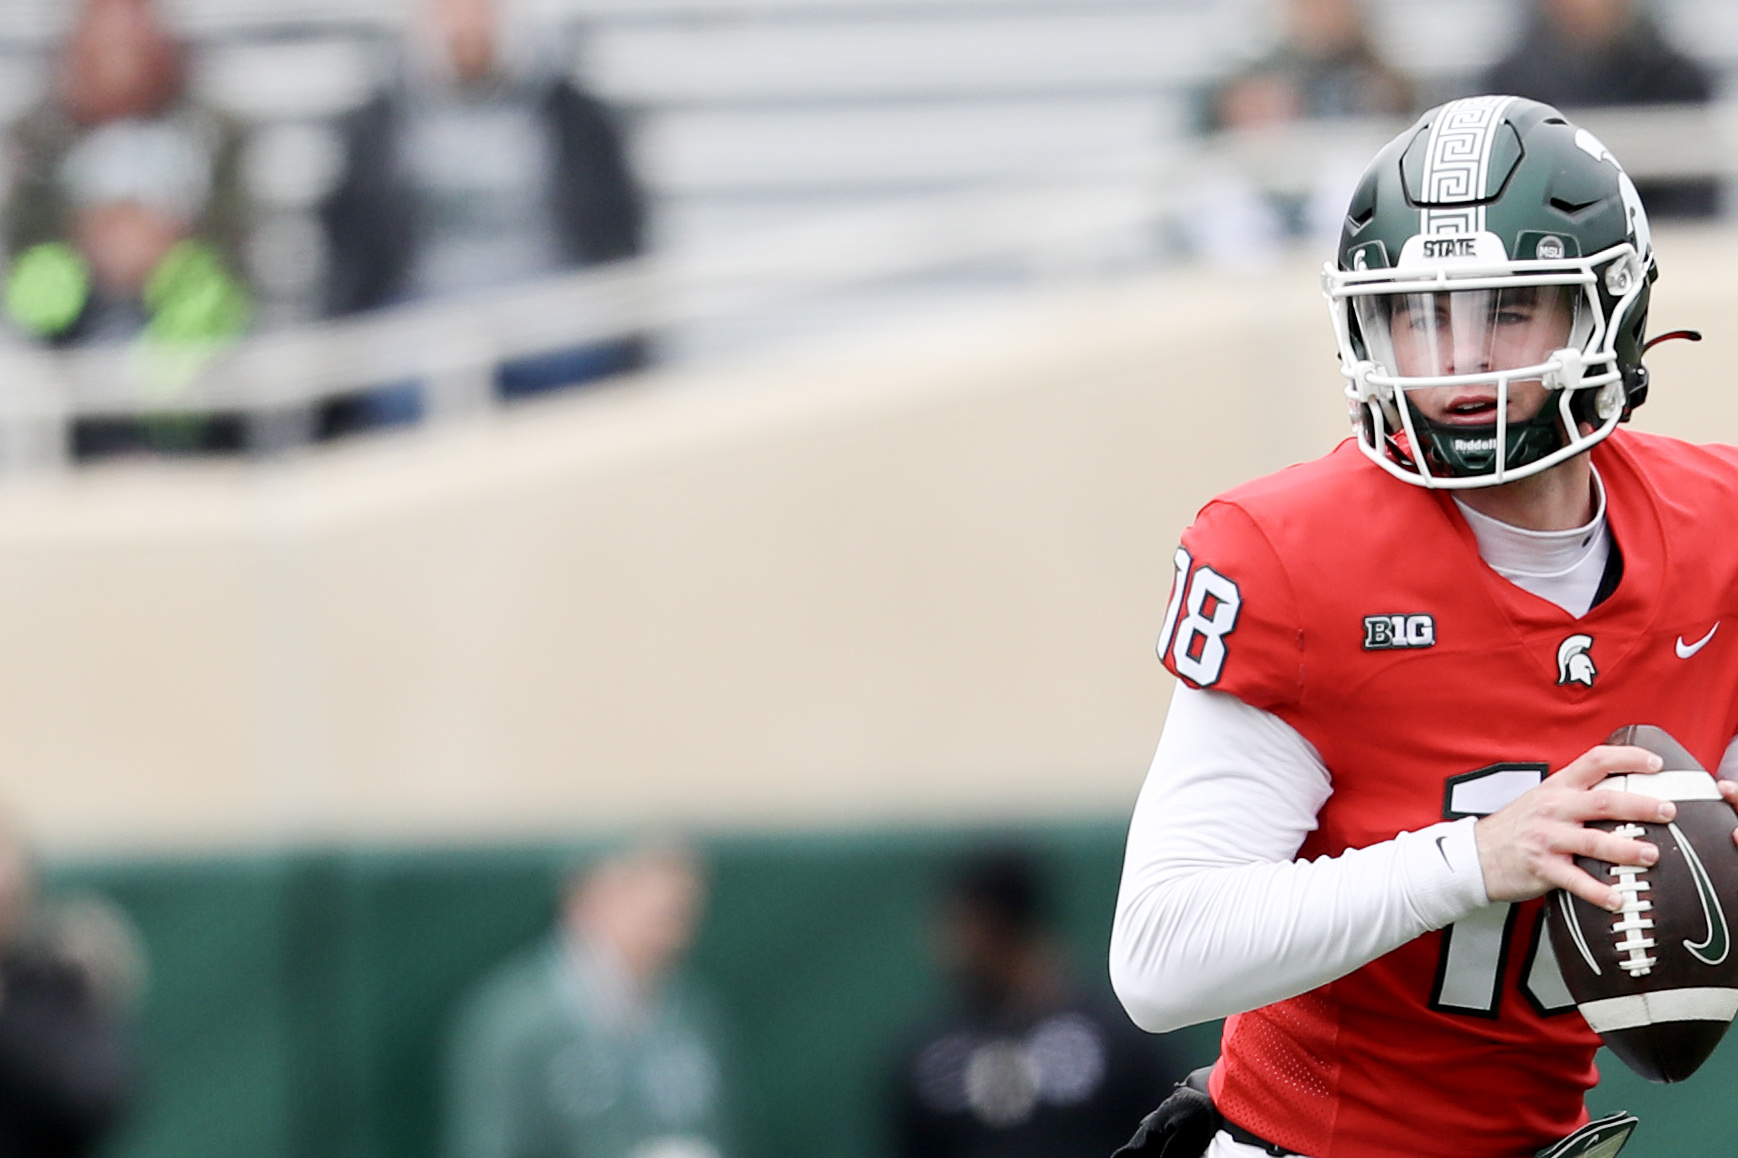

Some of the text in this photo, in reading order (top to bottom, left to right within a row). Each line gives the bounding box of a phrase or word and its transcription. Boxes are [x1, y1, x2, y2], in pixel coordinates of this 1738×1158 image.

[1423, 238, 1476, 258] STATE
[1539, 245, 1562, 259] MSU
[1156, 546, 1242, 688] 18
[1429, 762, 1577, 1020] 1
